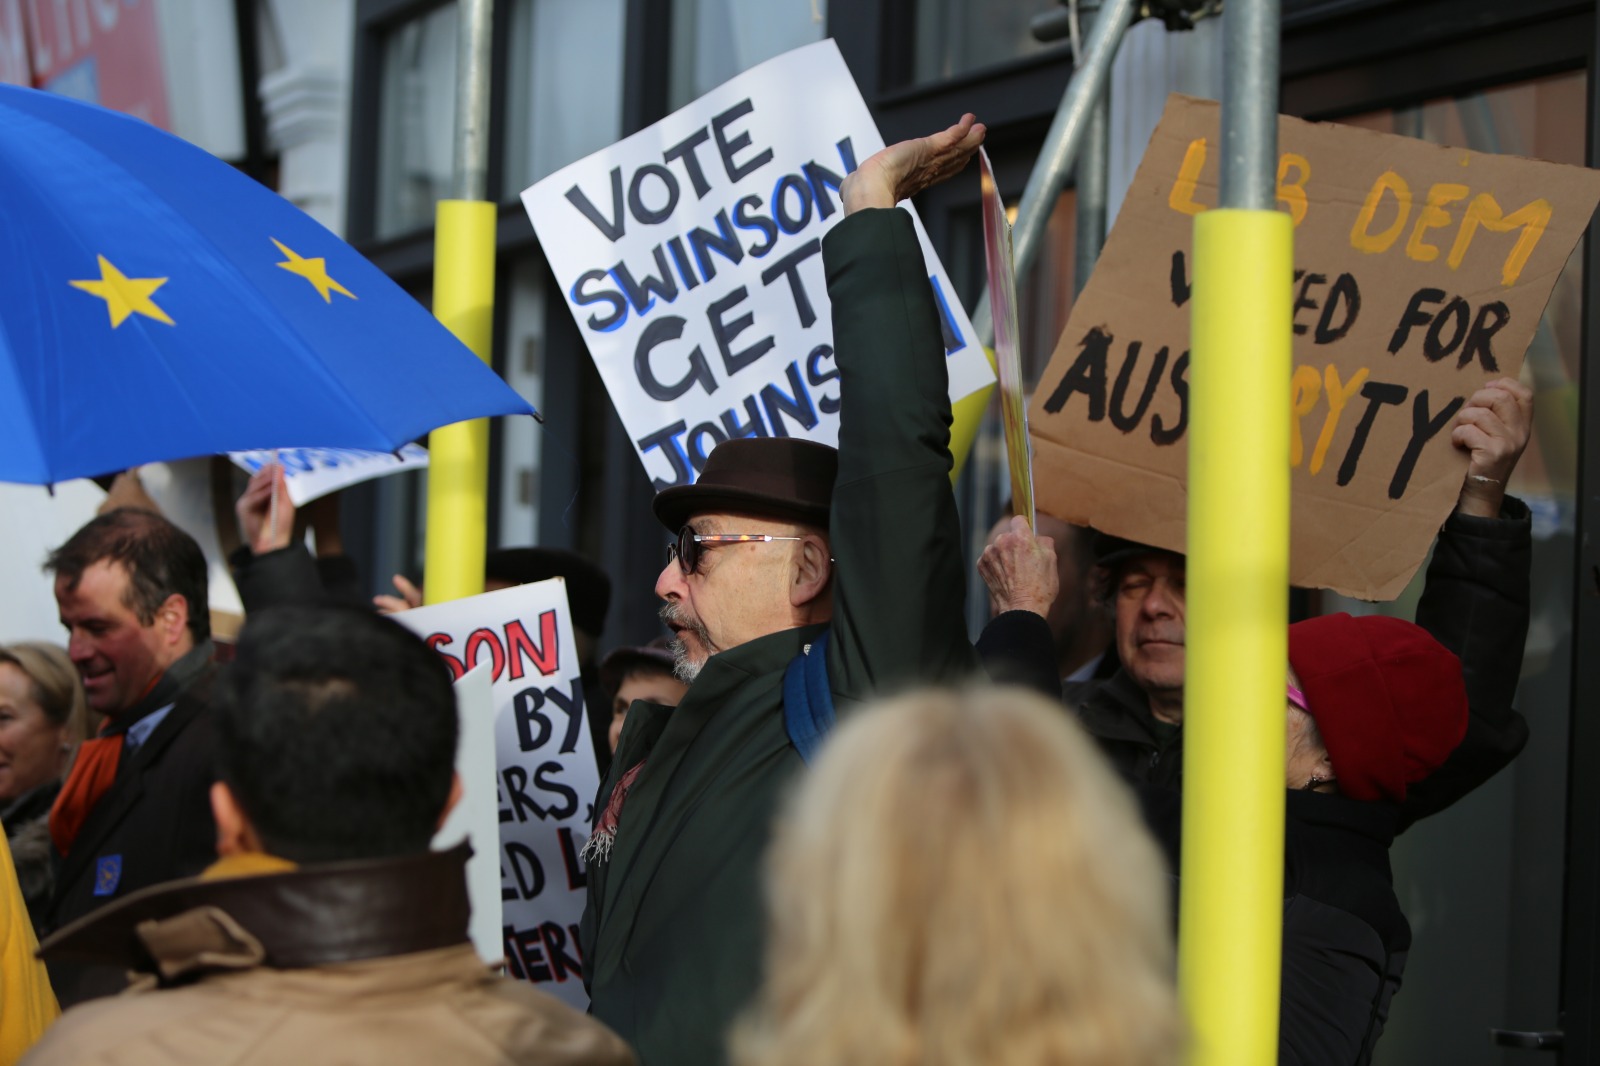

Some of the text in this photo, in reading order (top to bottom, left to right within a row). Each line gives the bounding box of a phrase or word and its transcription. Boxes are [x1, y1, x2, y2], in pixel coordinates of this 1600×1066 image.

[565, 98, 774, 242] VOTE
[570, 136, 858, 332] SWINSON
[1168, 137, 1553, 287] LB DEM
[634, 238, 822, 402] GET
[1387, 287, 1511, 373] FOR
[513, 676, 584, 755] BY
